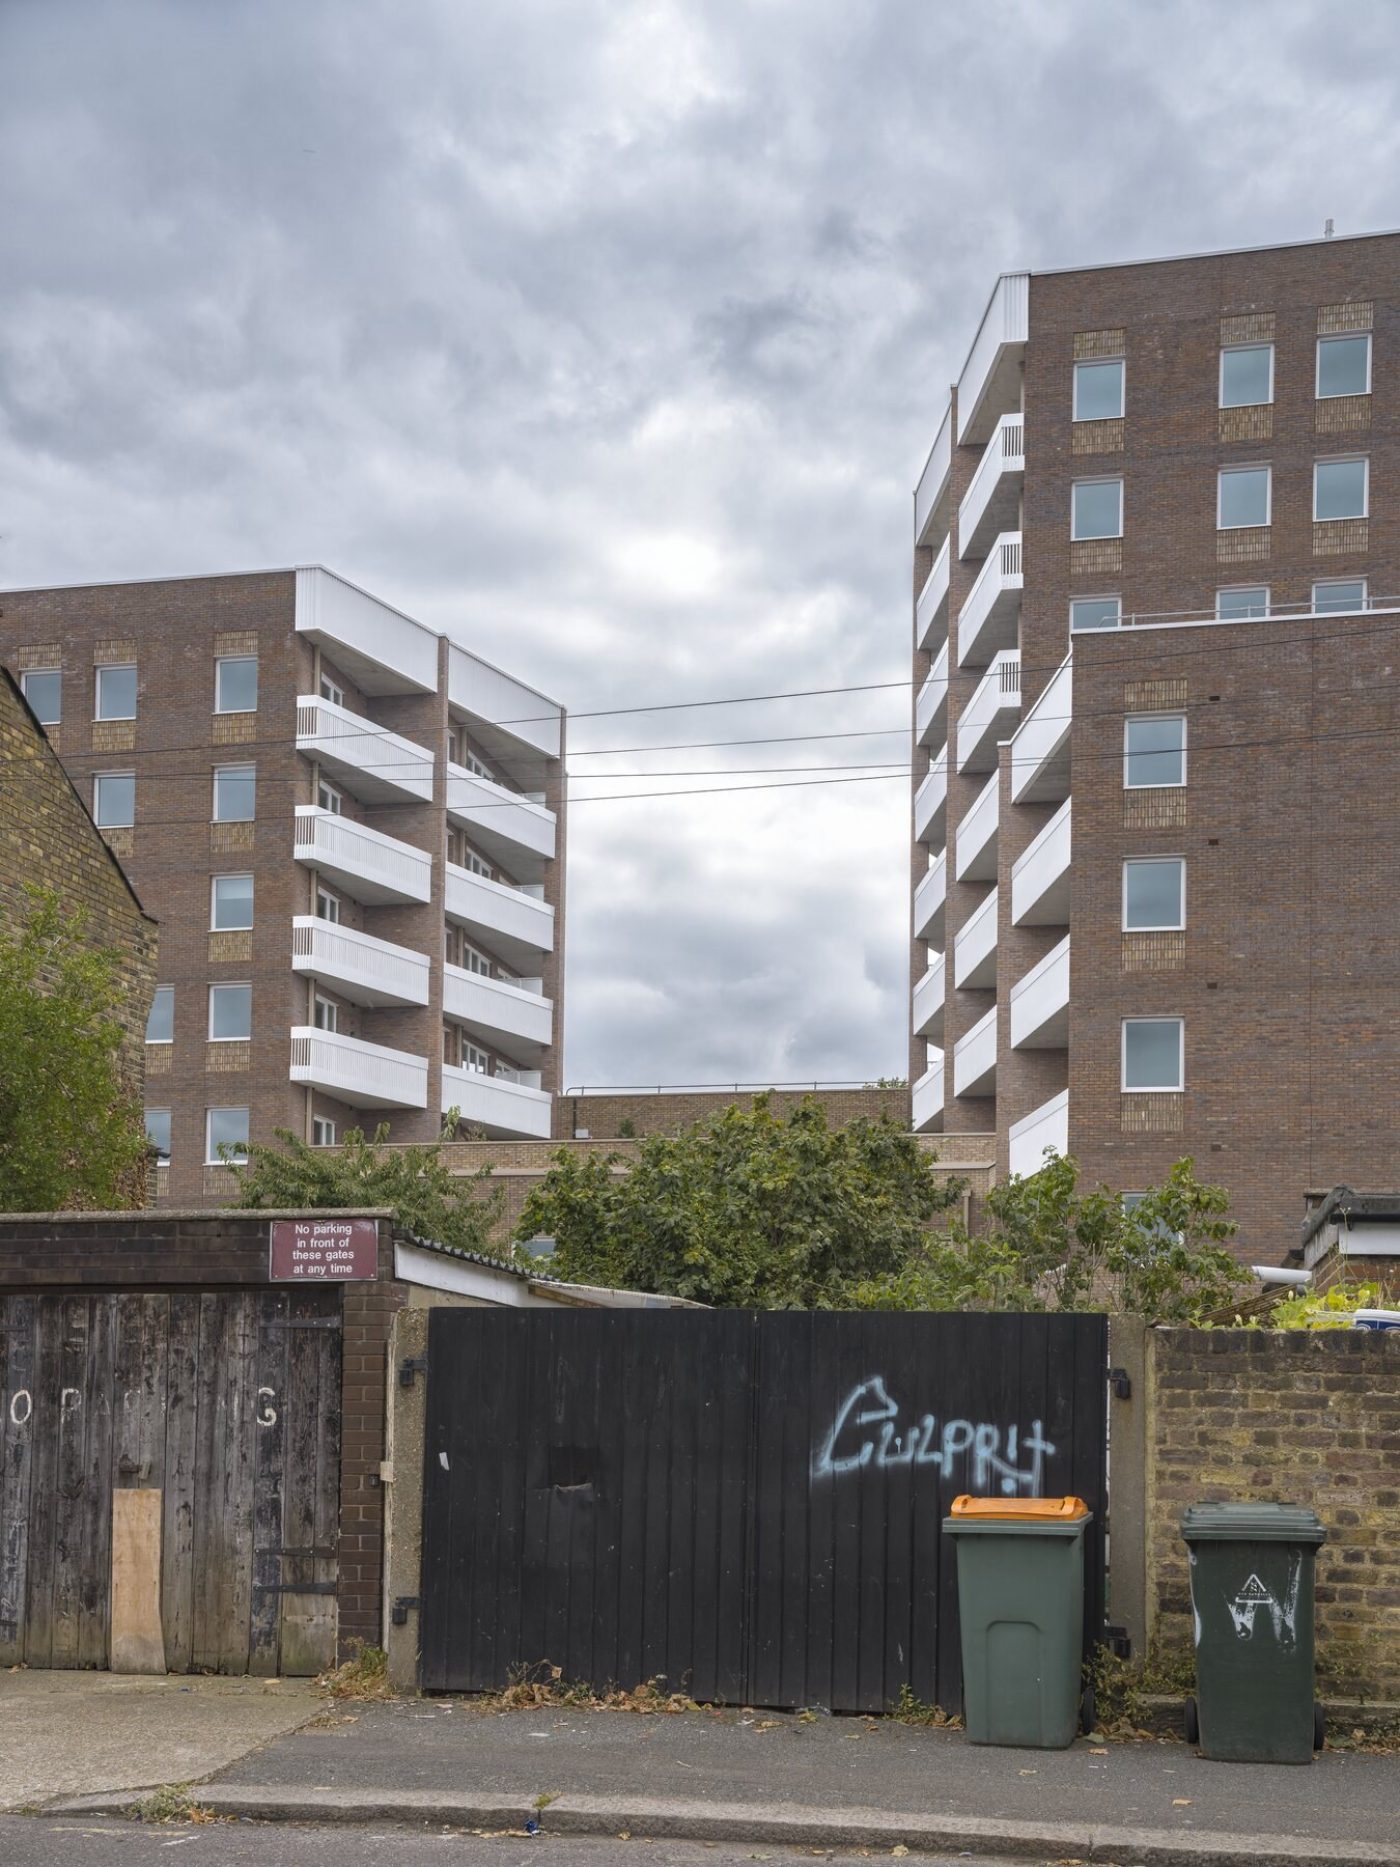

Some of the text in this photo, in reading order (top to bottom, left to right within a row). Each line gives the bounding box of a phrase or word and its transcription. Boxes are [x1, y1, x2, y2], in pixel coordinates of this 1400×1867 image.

[295, 1223, 352, 1236] No parking
[297, 1237, 350, 1248] in front of
[292, 1250, 355, 1261] these gates
[293, 1263, 353, 1276] at any time
